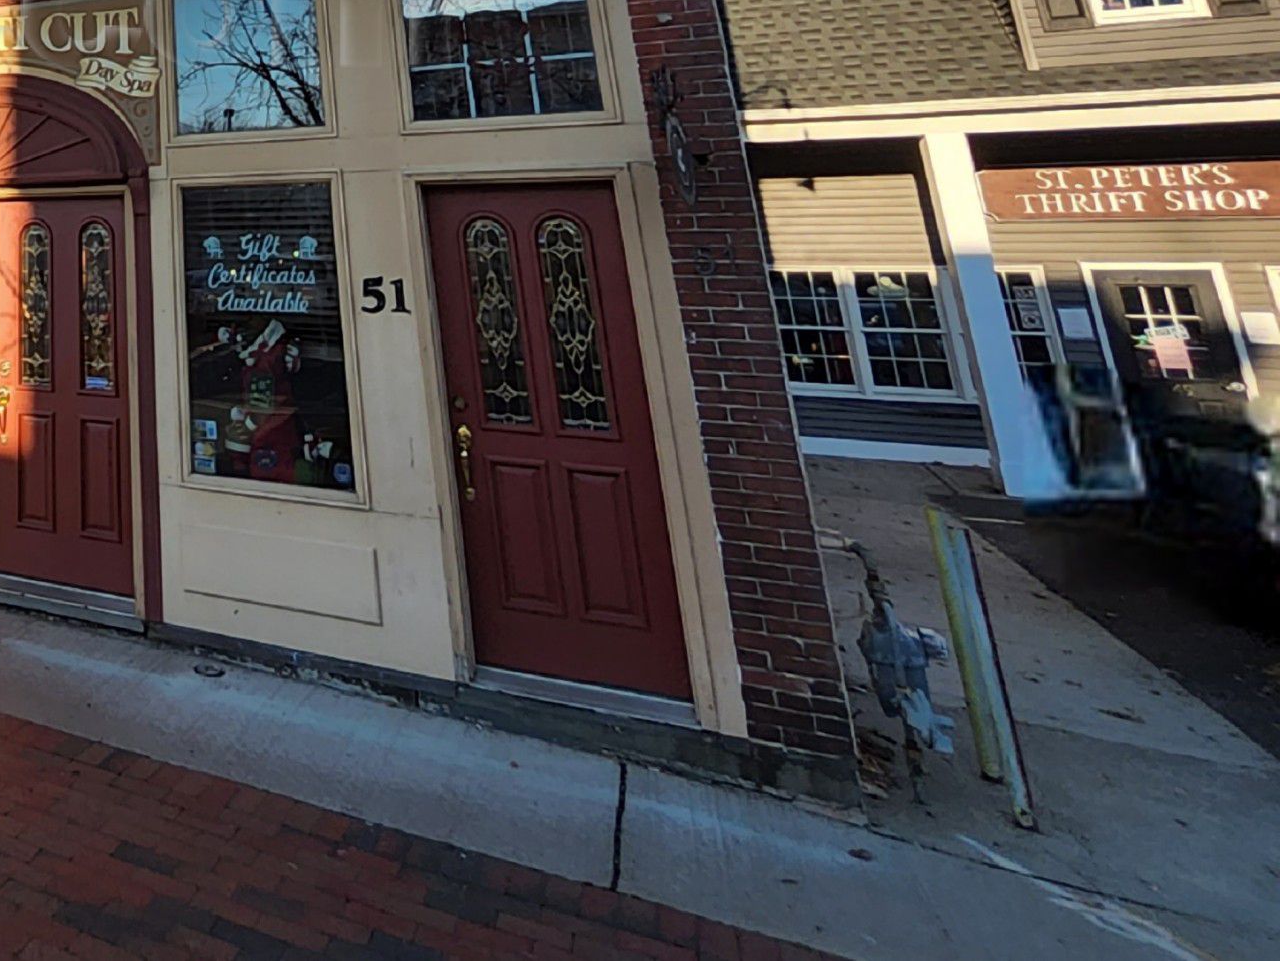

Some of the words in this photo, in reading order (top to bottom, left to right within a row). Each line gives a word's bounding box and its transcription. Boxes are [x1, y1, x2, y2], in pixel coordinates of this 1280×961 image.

[39, 7, 140, 55] CUT
[84, 59, 120, 84] Day
[120, 70, 153, 98] Spa
[1015, 191, 1147, 215] THRIFT
[1164, 189, 1271, 212] SHOP
[237, 233, 282, 261] Gift
[207, 263, 317, 289] Certificates
[217, 288, 311, 314] Available
[361, 276, 412, 315] 51
